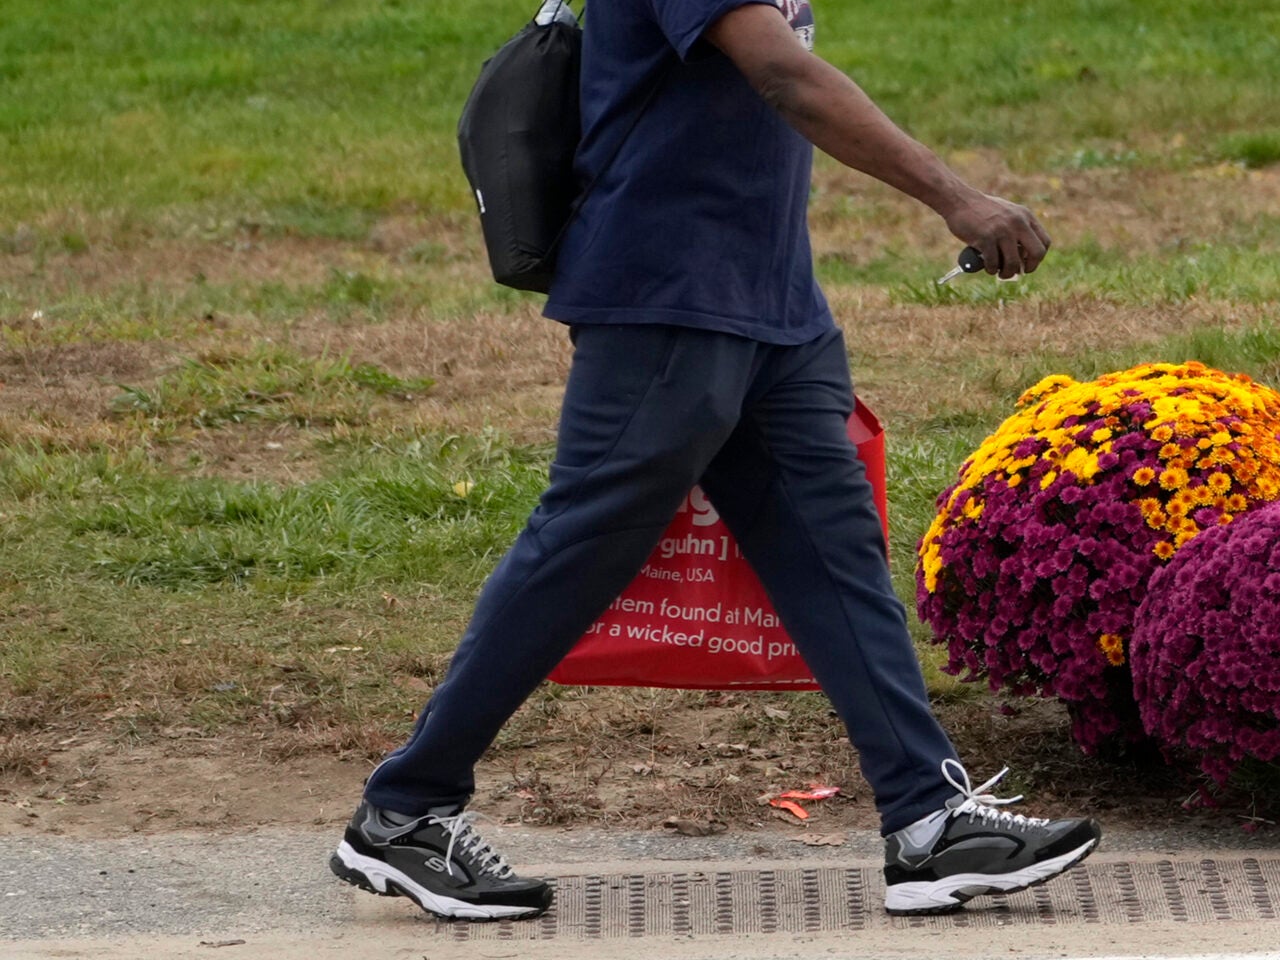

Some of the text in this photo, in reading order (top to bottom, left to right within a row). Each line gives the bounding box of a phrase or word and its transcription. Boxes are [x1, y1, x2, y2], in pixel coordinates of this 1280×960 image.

[686, 568, 715, 582] USA
[660, 598, 721, 623] found
[725, 607, 740, 625] at
[608, 623, 622, 637] a
[627, 625, 704, 647] wicked
[708, 635, 763, 654] good
[768, 641, 800, 660] pri
